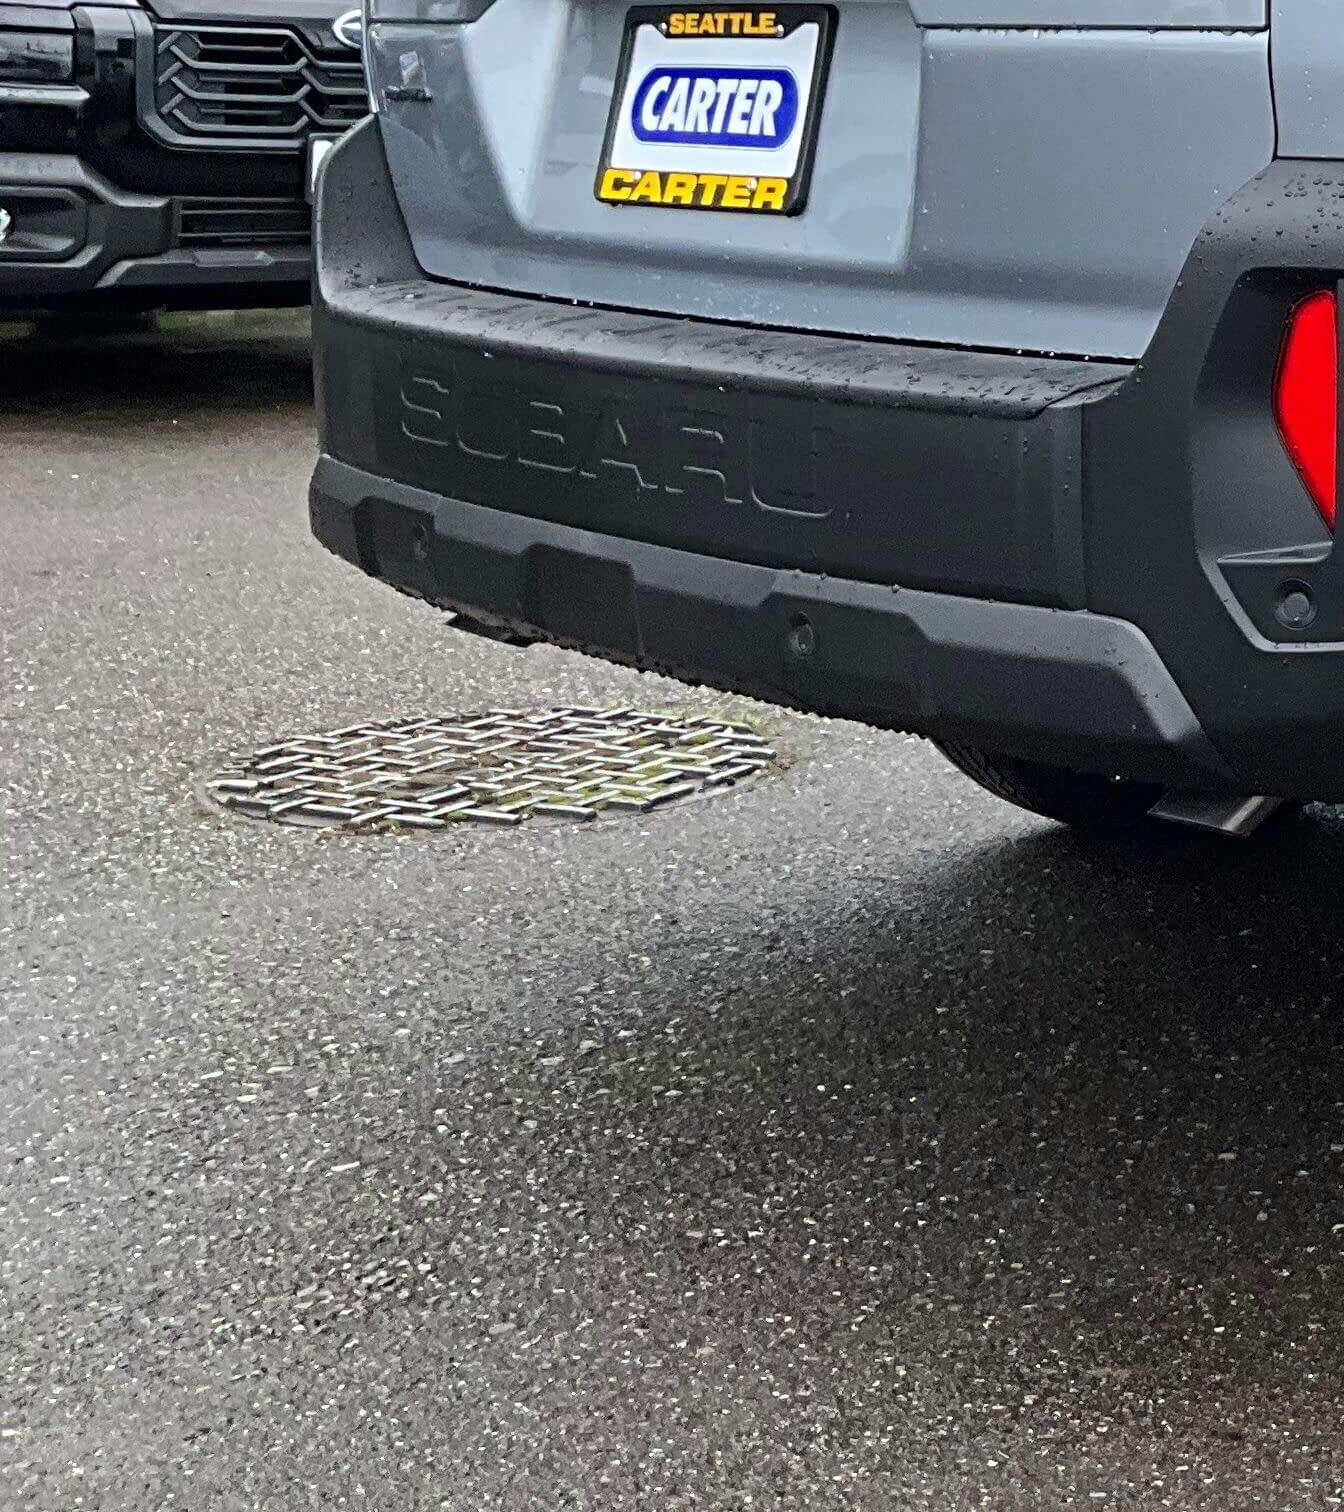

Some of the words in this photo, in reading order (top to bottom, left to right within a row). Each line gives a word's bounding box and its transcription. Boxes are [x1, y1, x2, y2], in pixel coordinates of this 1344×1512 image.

[669, 11, 777, 34] SEATTLE
[641, 75, 784, 137] CARTER
[599, 168, 788, 210] CARTER
[399, 375, 836, 520] SUBARU
